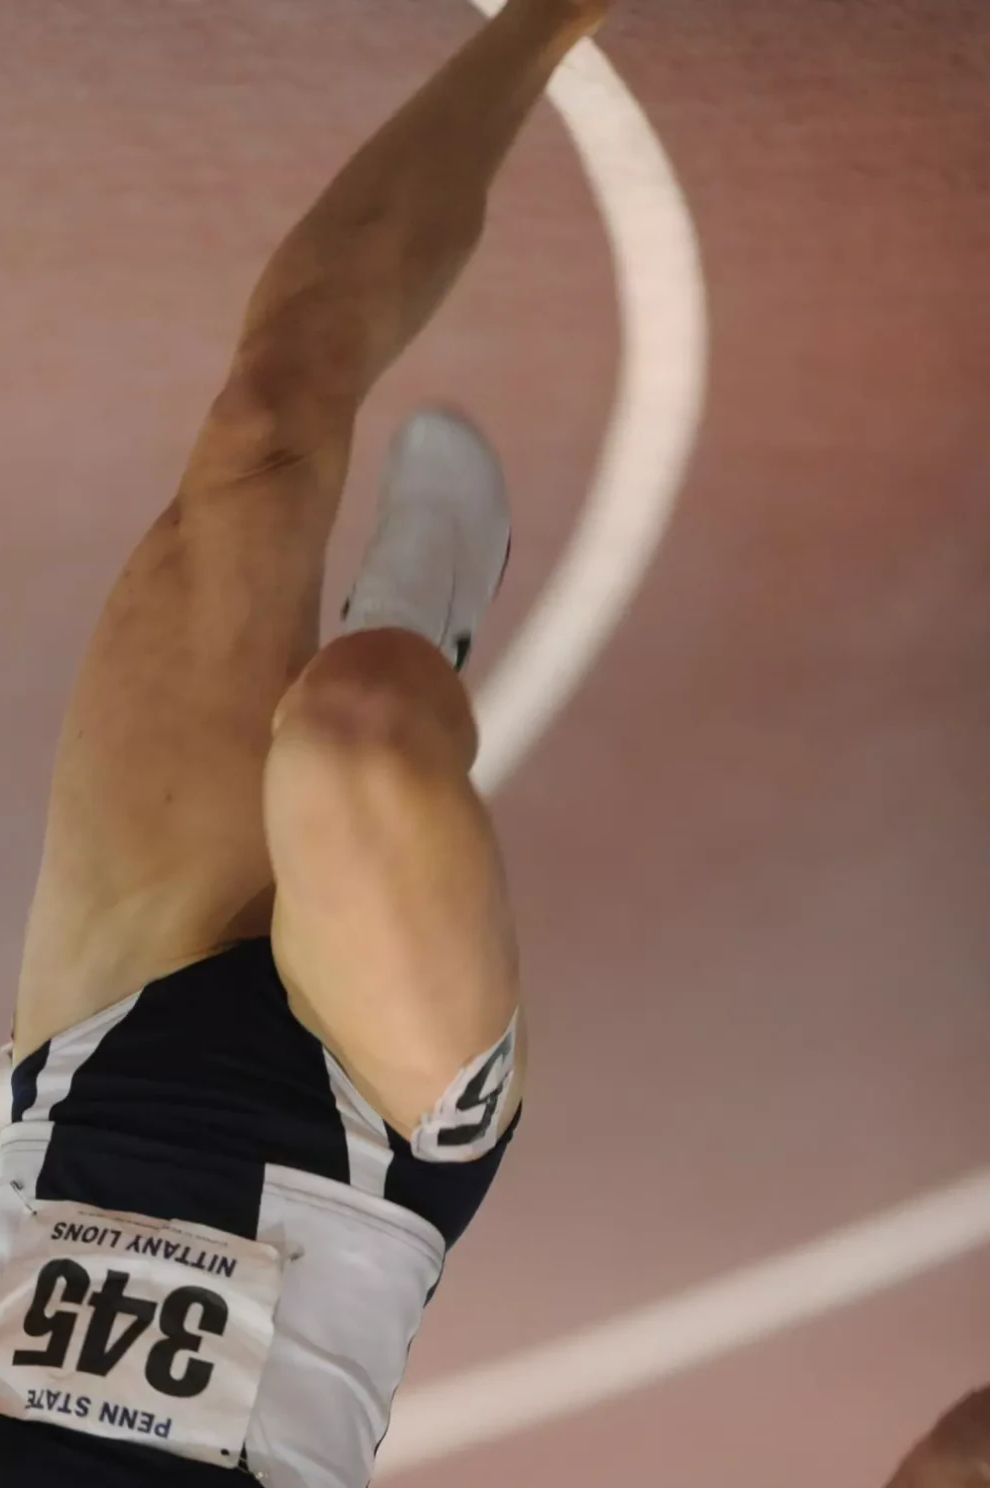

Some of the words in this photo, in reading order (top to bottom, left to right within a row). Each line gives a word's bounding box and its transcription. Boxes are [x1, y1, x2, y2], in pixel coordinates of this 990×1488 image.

[51, 1221, 122, 1248] LIONS
[125, 1233, 237, 1278] NITTANY
[12, 1258, 228, 1398] 345
[24, 1388, 91, 1418] STATE
[98, 1401, 173, 1439] PENN
